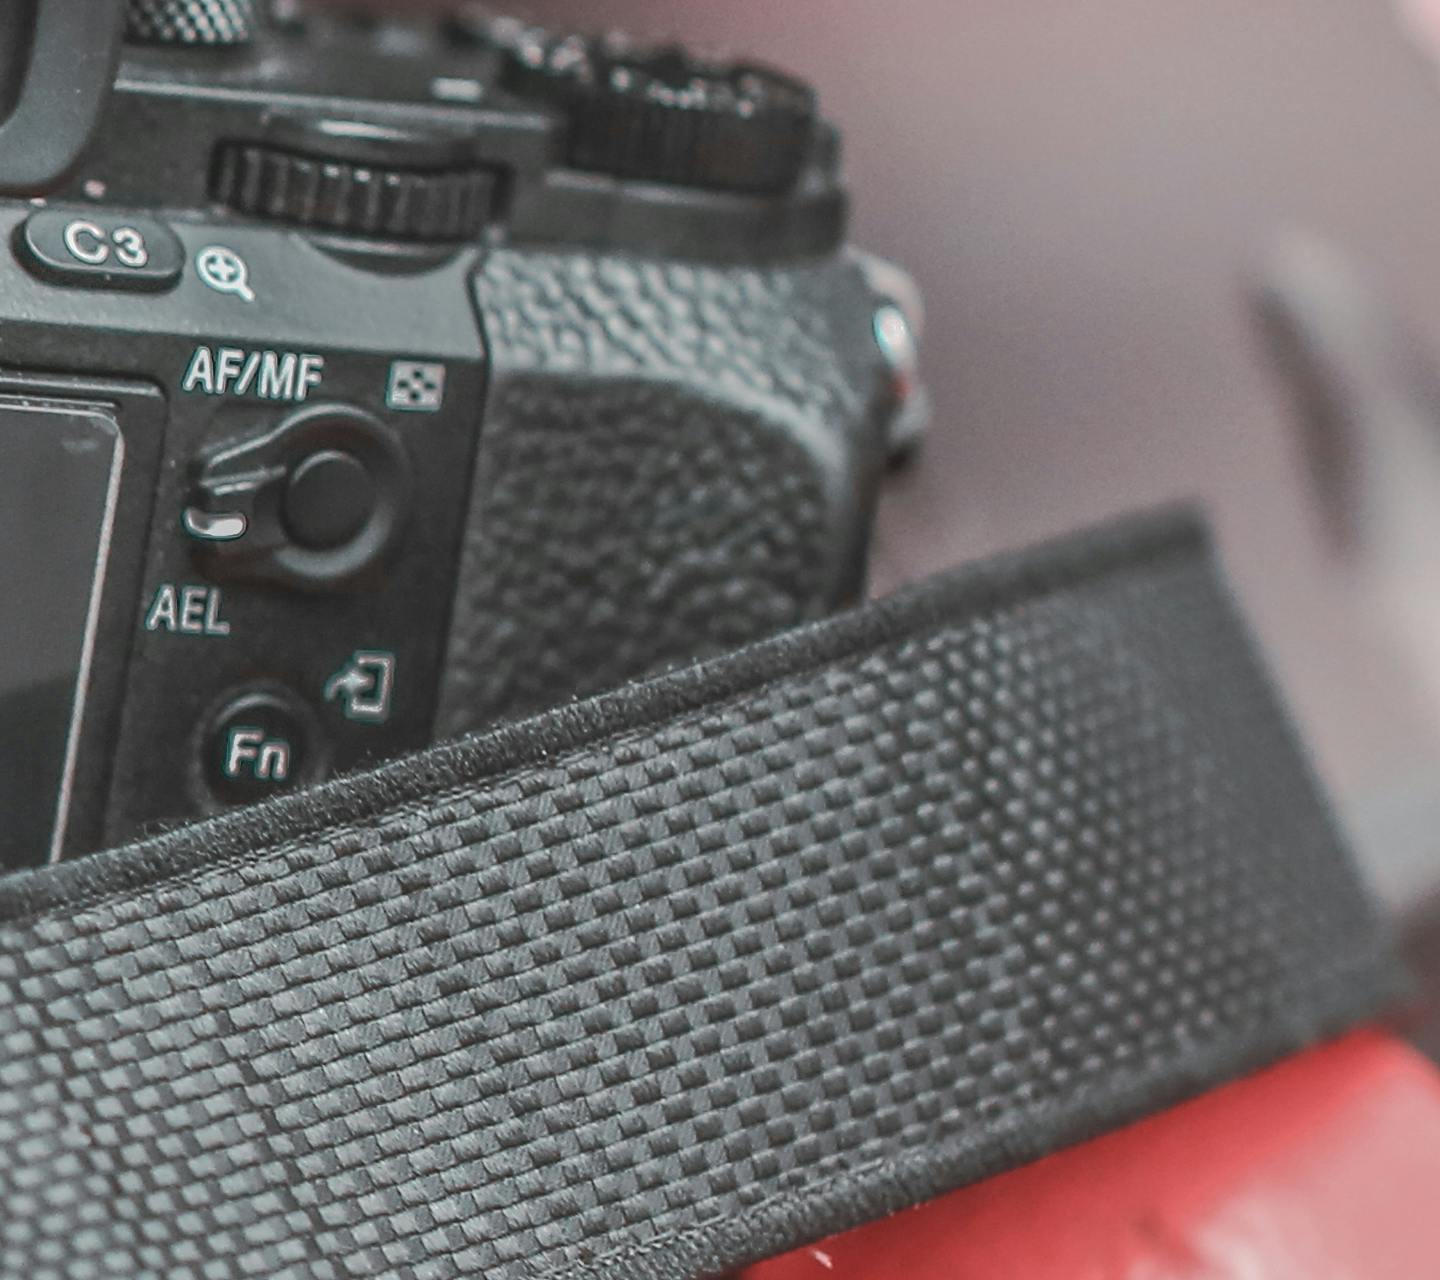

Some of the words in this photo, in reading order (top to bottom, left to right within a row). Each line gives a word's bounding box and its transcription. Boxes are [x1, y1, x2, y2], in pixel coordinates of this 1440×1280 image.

[62, 220, 150, 270] C3
[182, 346, 325, 401] AF/MF
[145, 584, 231, 635] AEL
[224, 728, 290, 779] Fn
